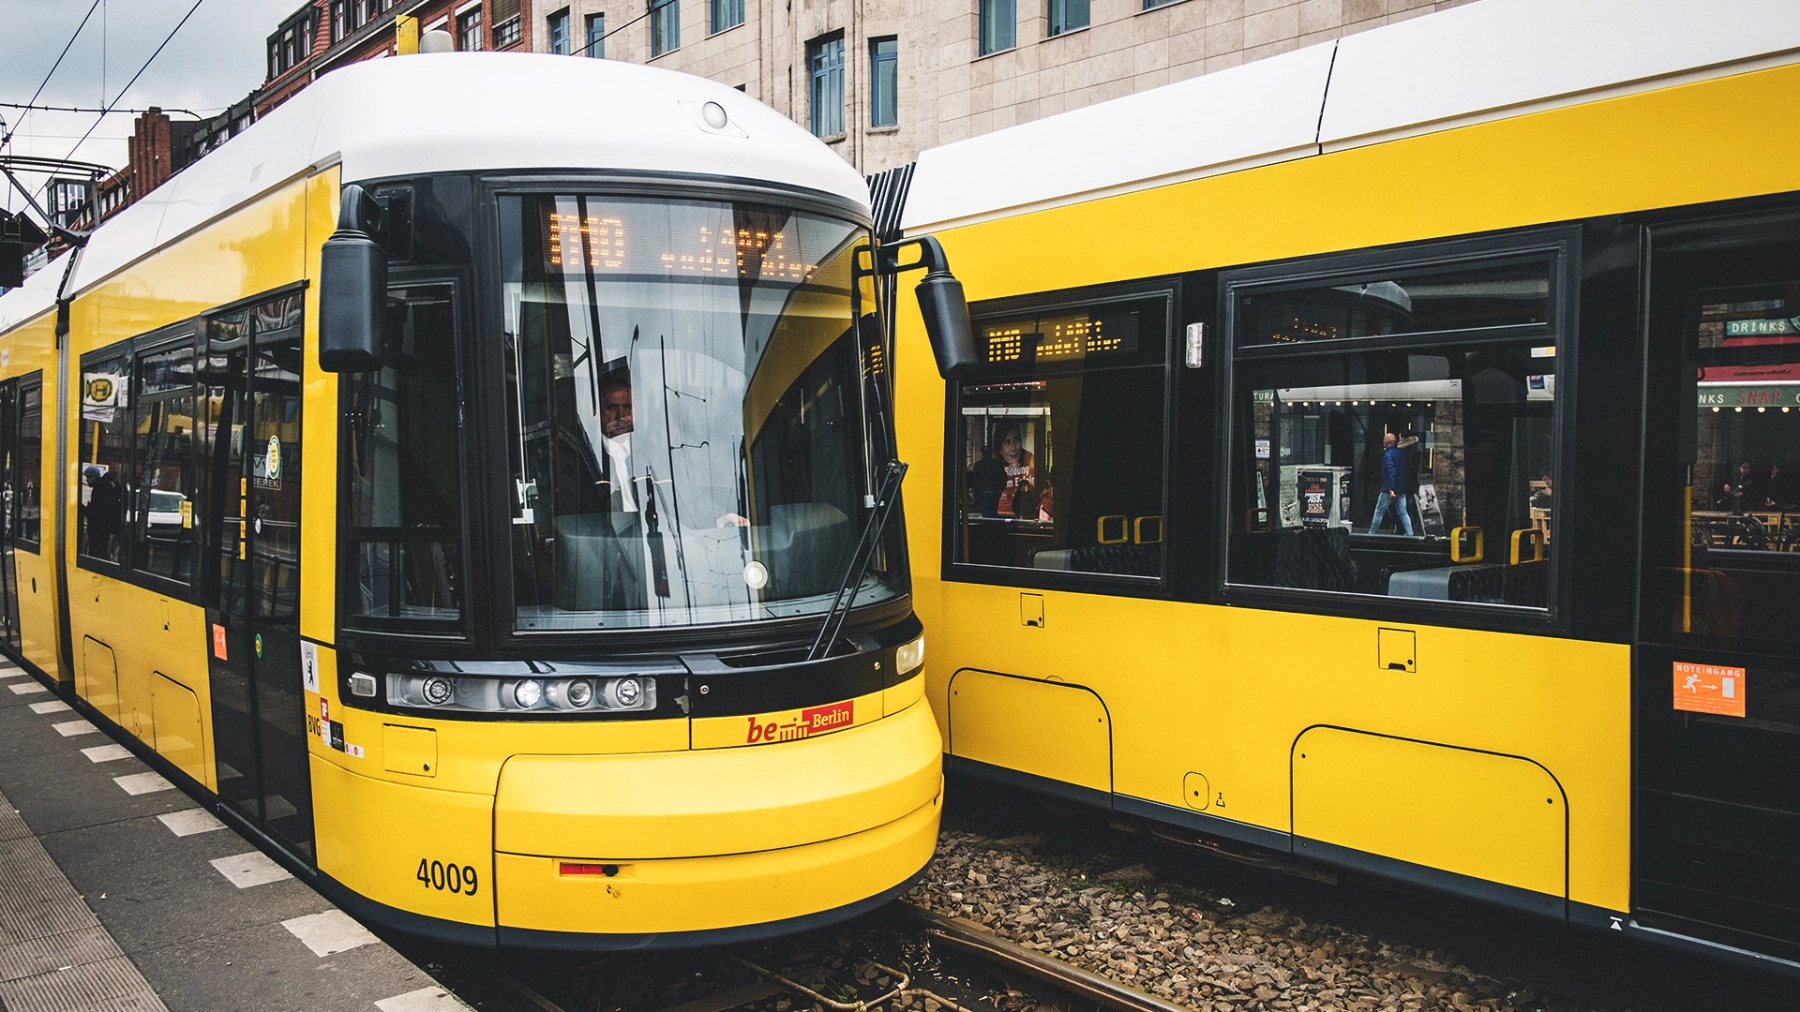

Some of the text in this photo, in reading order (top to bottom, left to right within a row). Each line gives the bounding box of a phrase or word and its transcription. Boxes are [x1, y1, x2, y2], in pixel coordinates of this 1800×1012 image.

[550, 213, 624, 267] M10
[1731, 321, 1786, 333] DRINKS
[989, 329, 1021, 362] M10
[1739, 389, 1781, 405] SNAP
[1676, 664, 1741, 678] NOTEINGANG
[308, 714, 321, 737] BVG
[812, 709, 849, 728] Berlin
[416, 858, 478, 896] 4009
